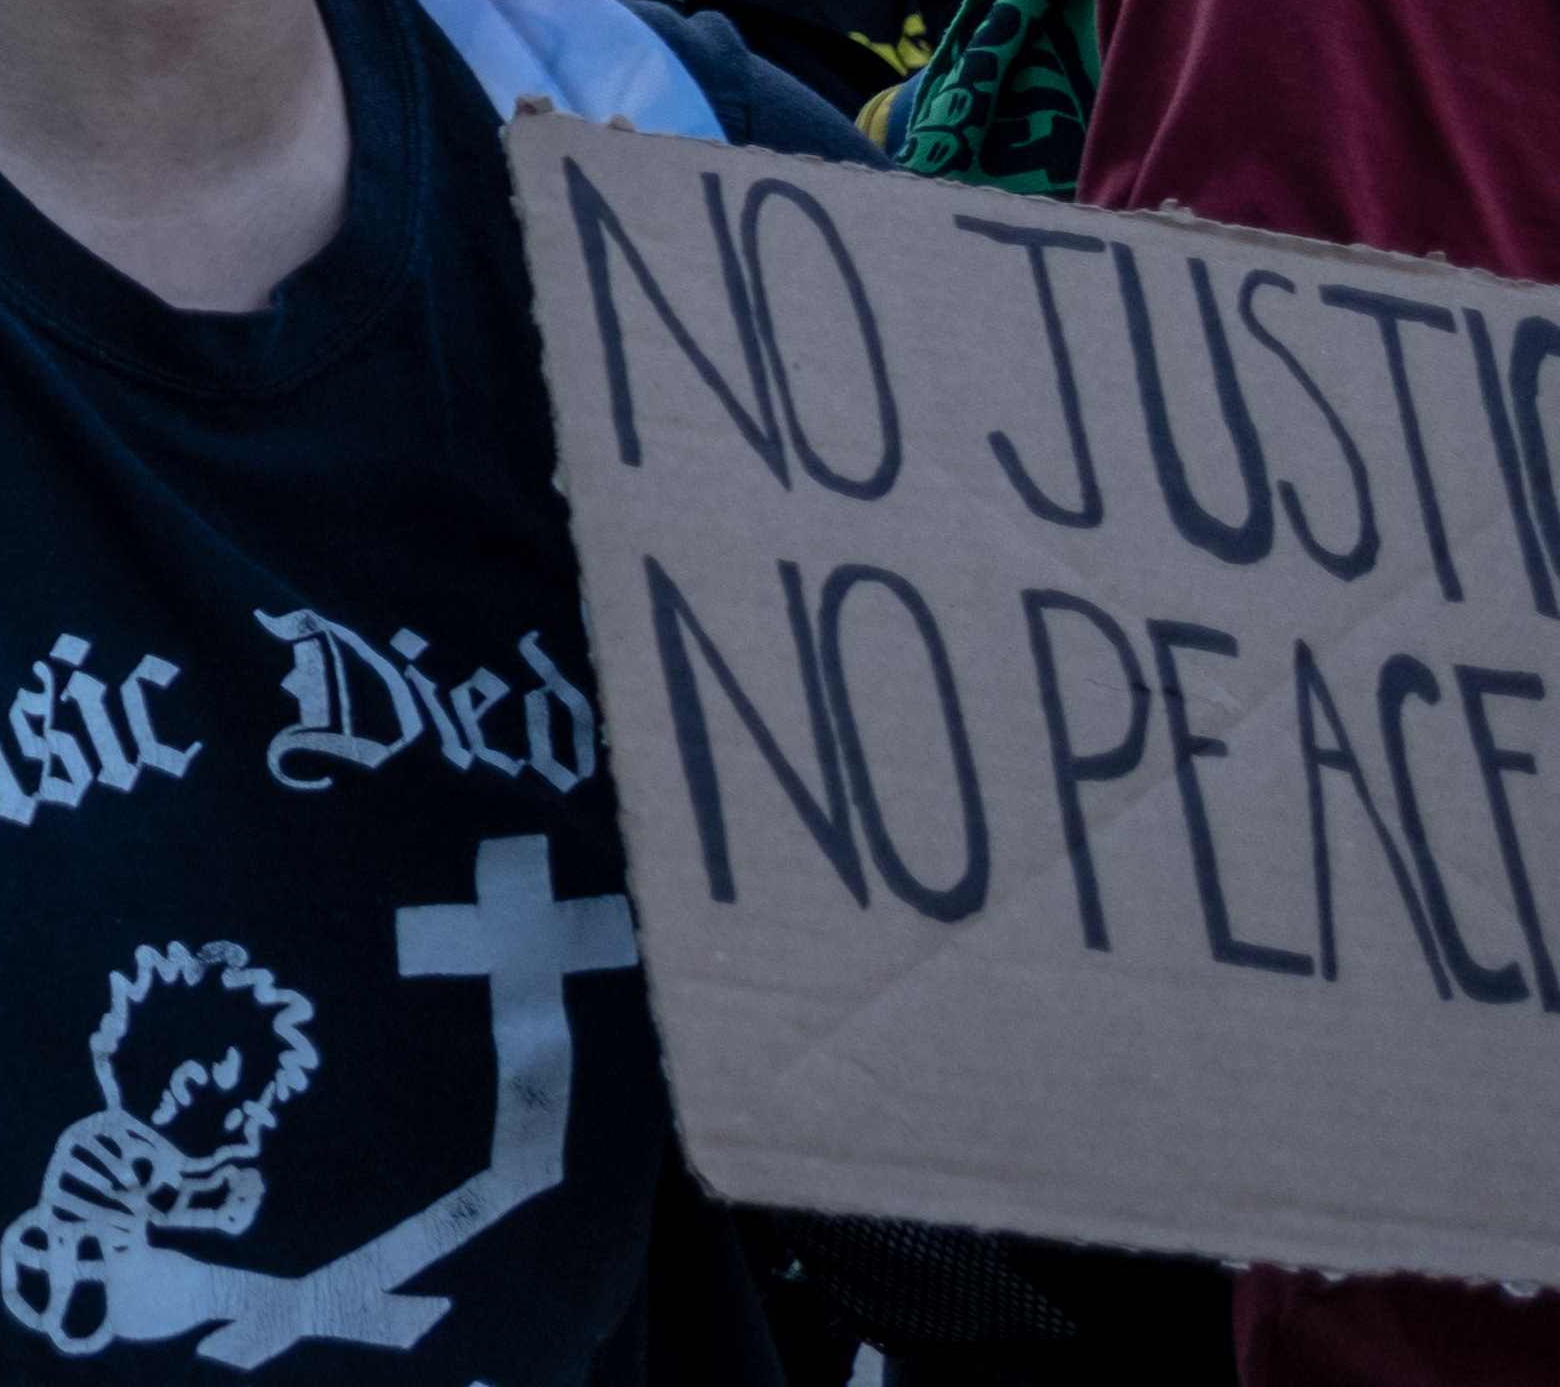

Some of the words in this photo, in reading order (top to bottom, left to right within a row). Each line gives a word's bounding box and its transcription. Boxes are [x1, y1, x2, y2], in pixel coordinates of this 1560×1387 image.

[564, 156, 903, 501] NO
[254, 608, 597, 793] Died
[643, 555, 992, 924] NO
[1022, 587, 1560, 1014] PEACE
